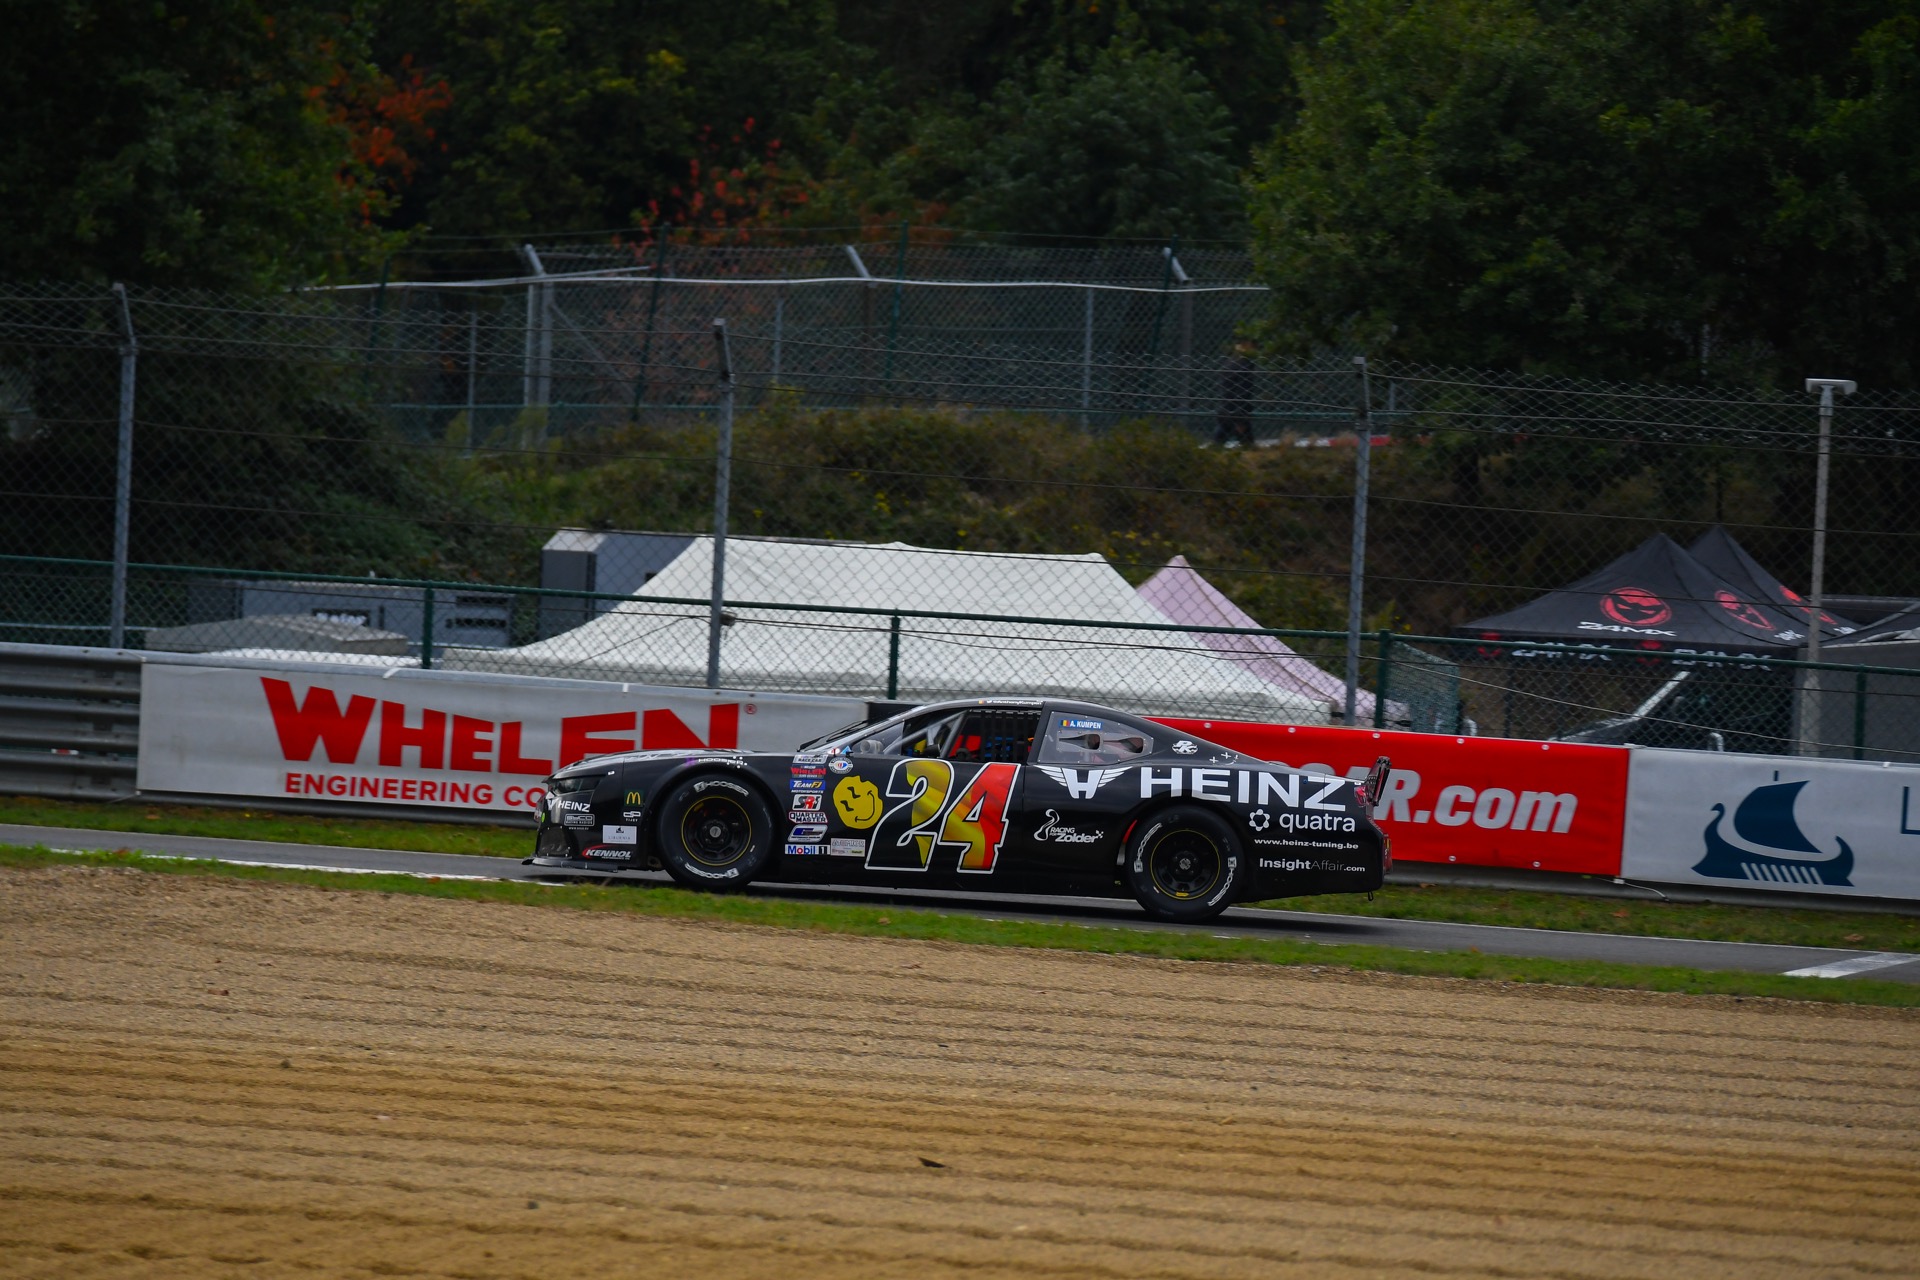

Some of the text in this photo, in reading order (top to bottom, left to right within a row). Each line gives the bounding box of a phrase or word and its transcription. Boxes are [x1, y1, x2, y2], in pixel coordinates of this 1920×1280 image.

[1577, 621, 1677, 636] 24MX
[1076, 720, 1102, 730] KUMPEN
[285, 772, 494, 806] ENGINEERING
[1140, 766, 1346, 812] HEINZ
[557, 800, 591, 813] HEINZ
[865, 758, 1021, 874] 24
[1278, 812, 1356, 833] quatra
[1050, 826, 1076, 834] RACING
[1054, 832, 1096, 843] Zolder
[1253, 838, 1359, 850] www.heinz-tuning.be
[585, 849, 632, 858] KENNOL
[787, 845, 816, 855] Mobil
[1259, 857, 1366, 873] InsightAffair.com
